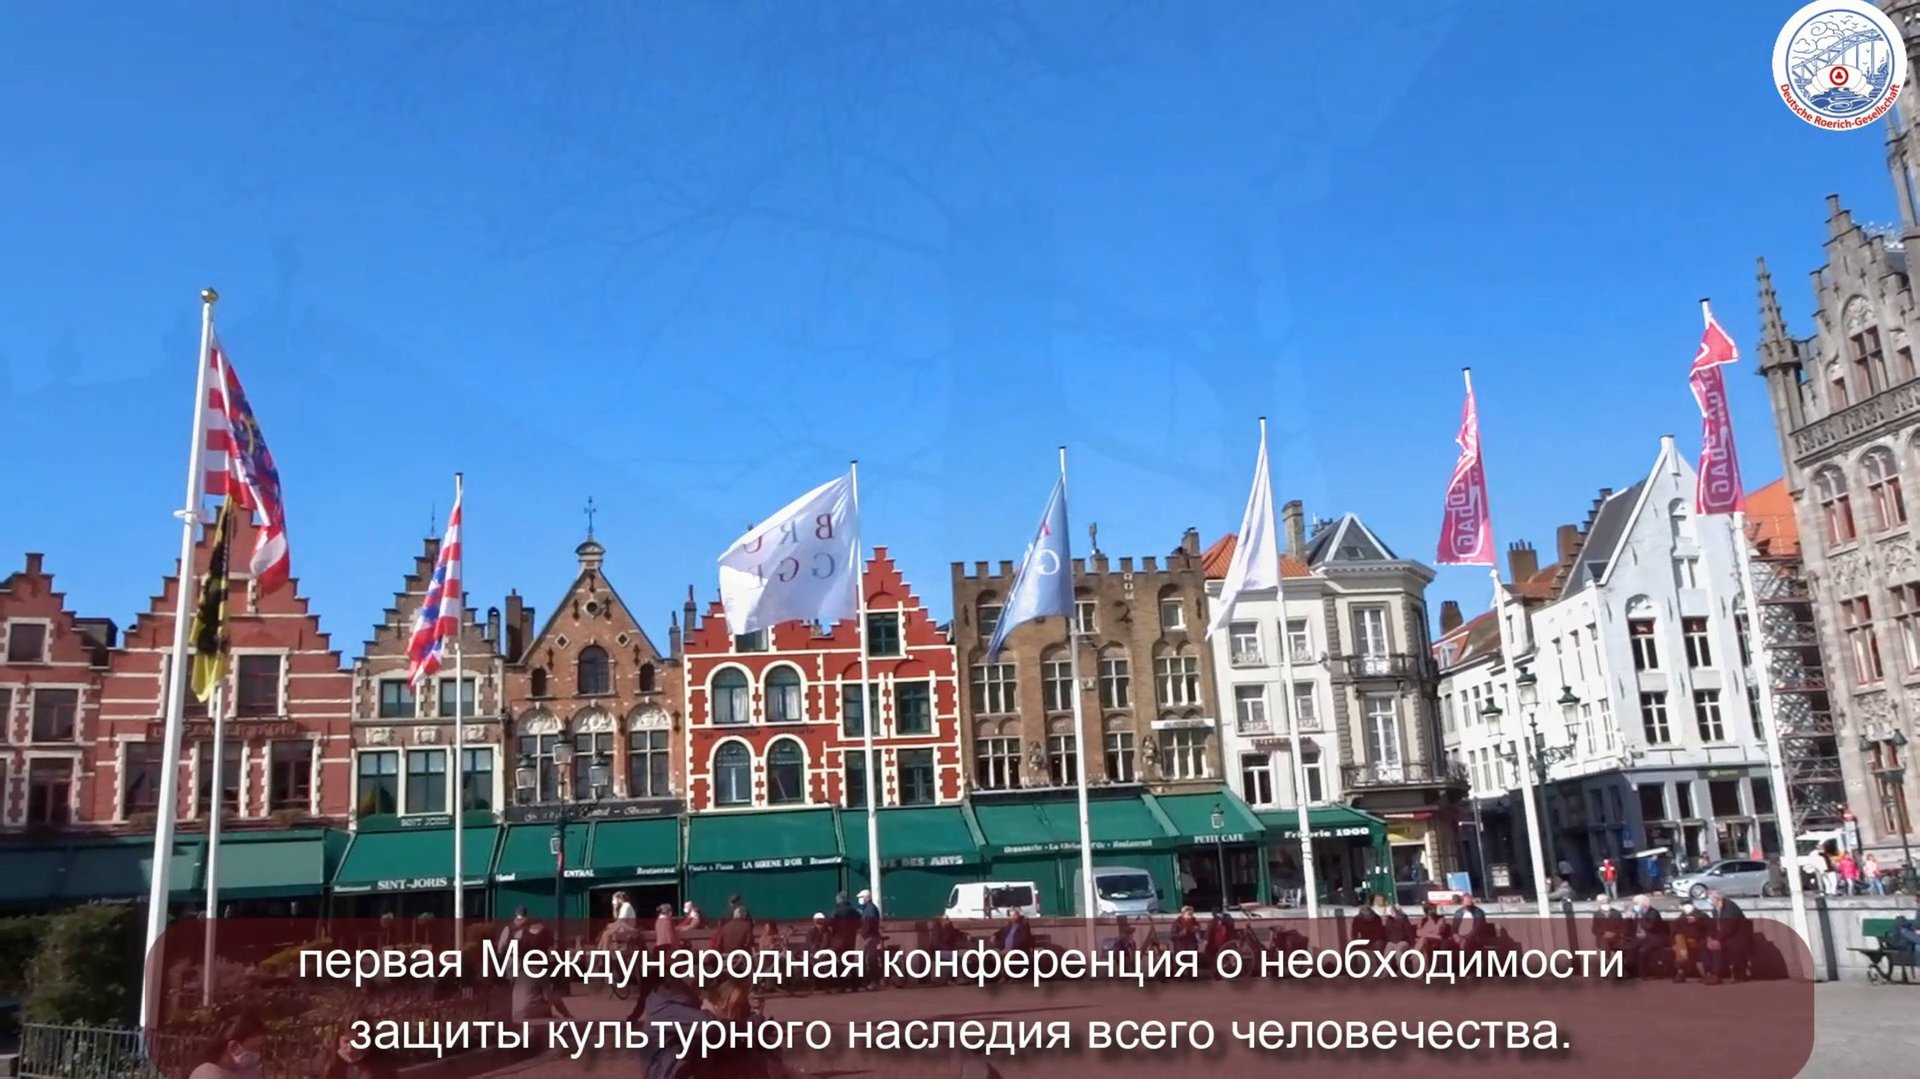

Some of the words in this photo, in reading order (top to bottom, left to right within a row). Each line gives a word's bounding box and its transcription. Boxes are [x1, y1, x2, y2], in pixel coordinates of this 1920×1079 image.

[1336, 827, 1370, 837] 1900
[930, 855, 964, 866] ARTS
[564, 869, 595, 878] ENTRAL
[377, 877, 448, 890] SINT-JORIS
